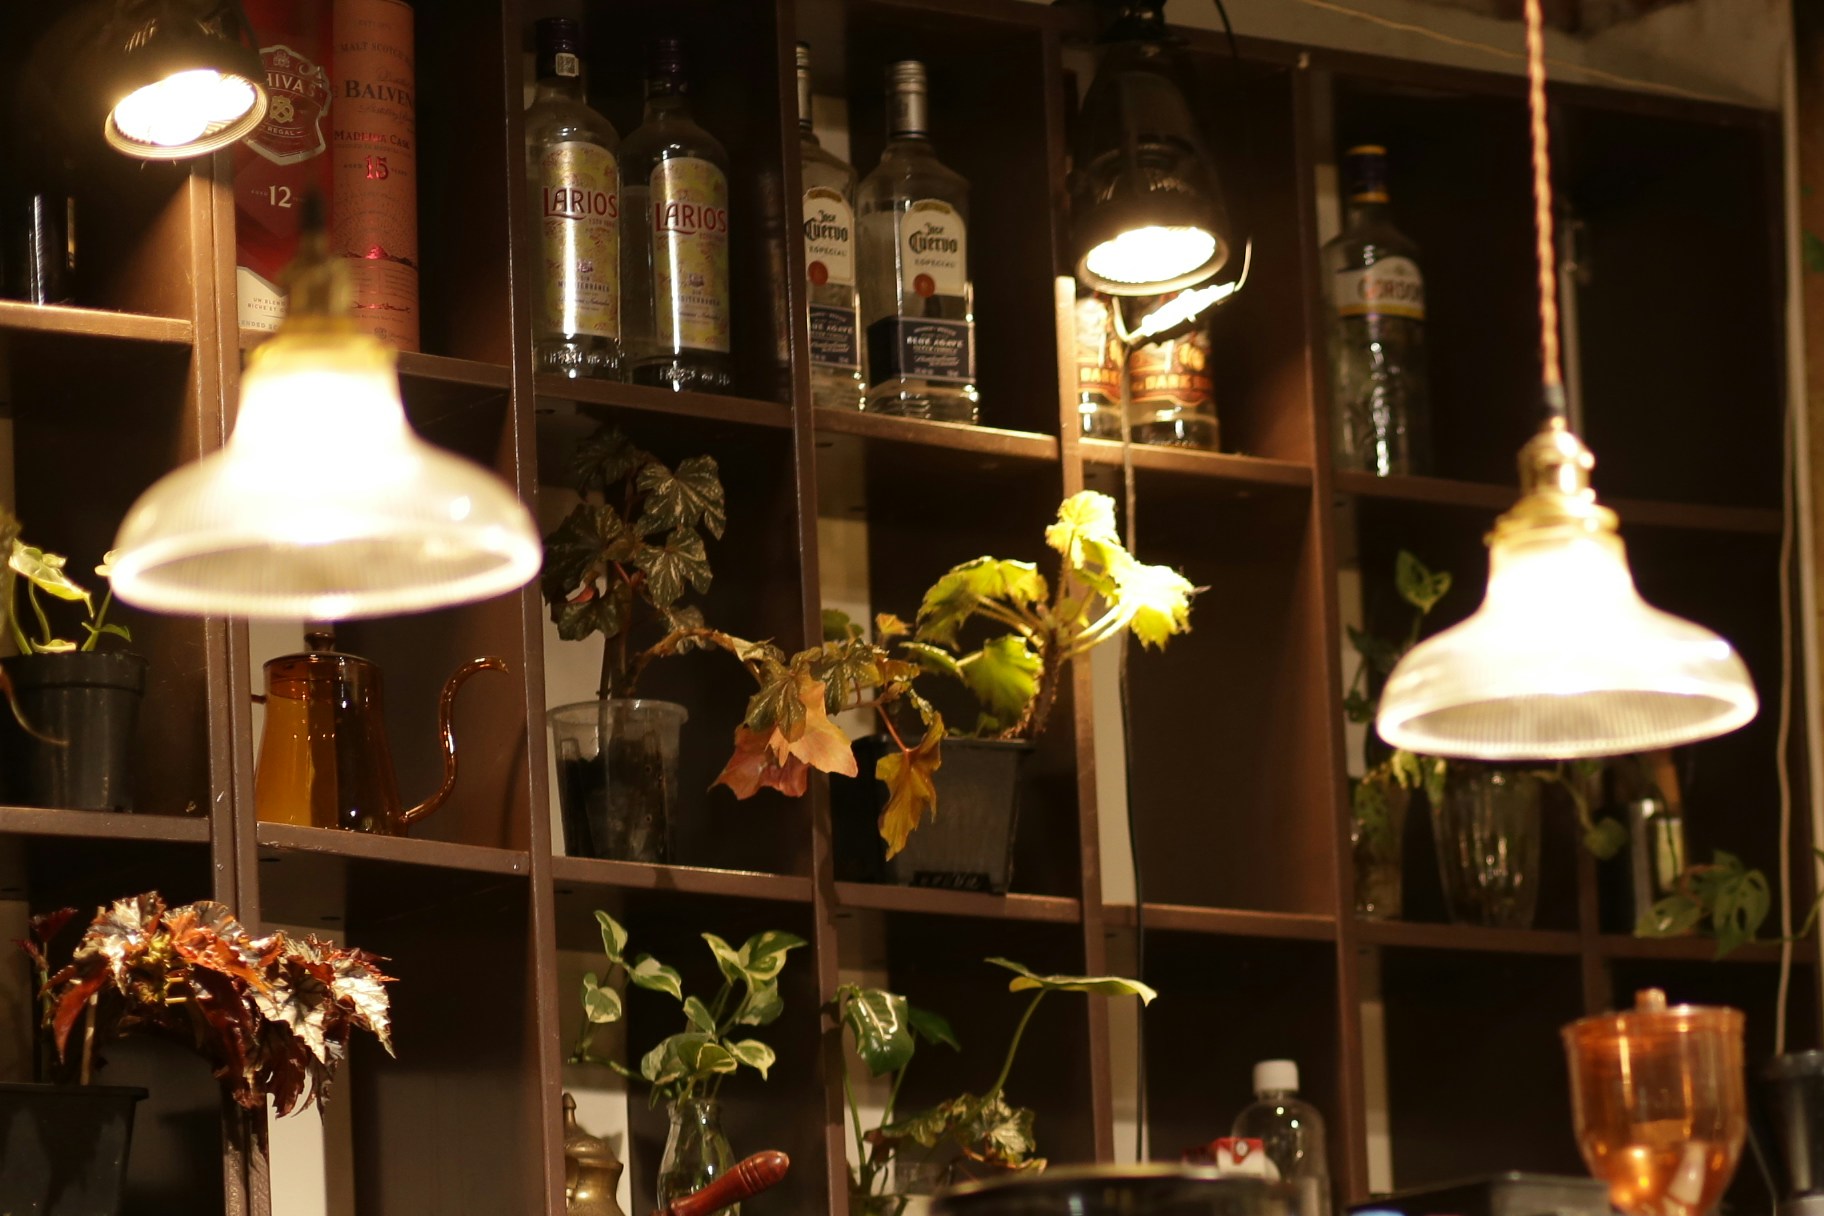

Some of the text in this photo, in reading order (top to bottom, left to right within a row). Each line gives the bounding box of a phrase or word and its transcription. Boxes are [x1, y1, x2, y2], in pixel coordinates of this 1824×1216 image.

[266, 72, 316, 98] HIVAS
[267, 125, 295, 137] REGAL
[364, 154, 389, 181] 15
[268, 184, 292, 209] 12
[543, 187, 618, 221] LARIOS
[655, 202, 727, 236] LARIOS
[803, 216, 849, 242] Cuervo
[908, 230, 958, 254] Cuervo
